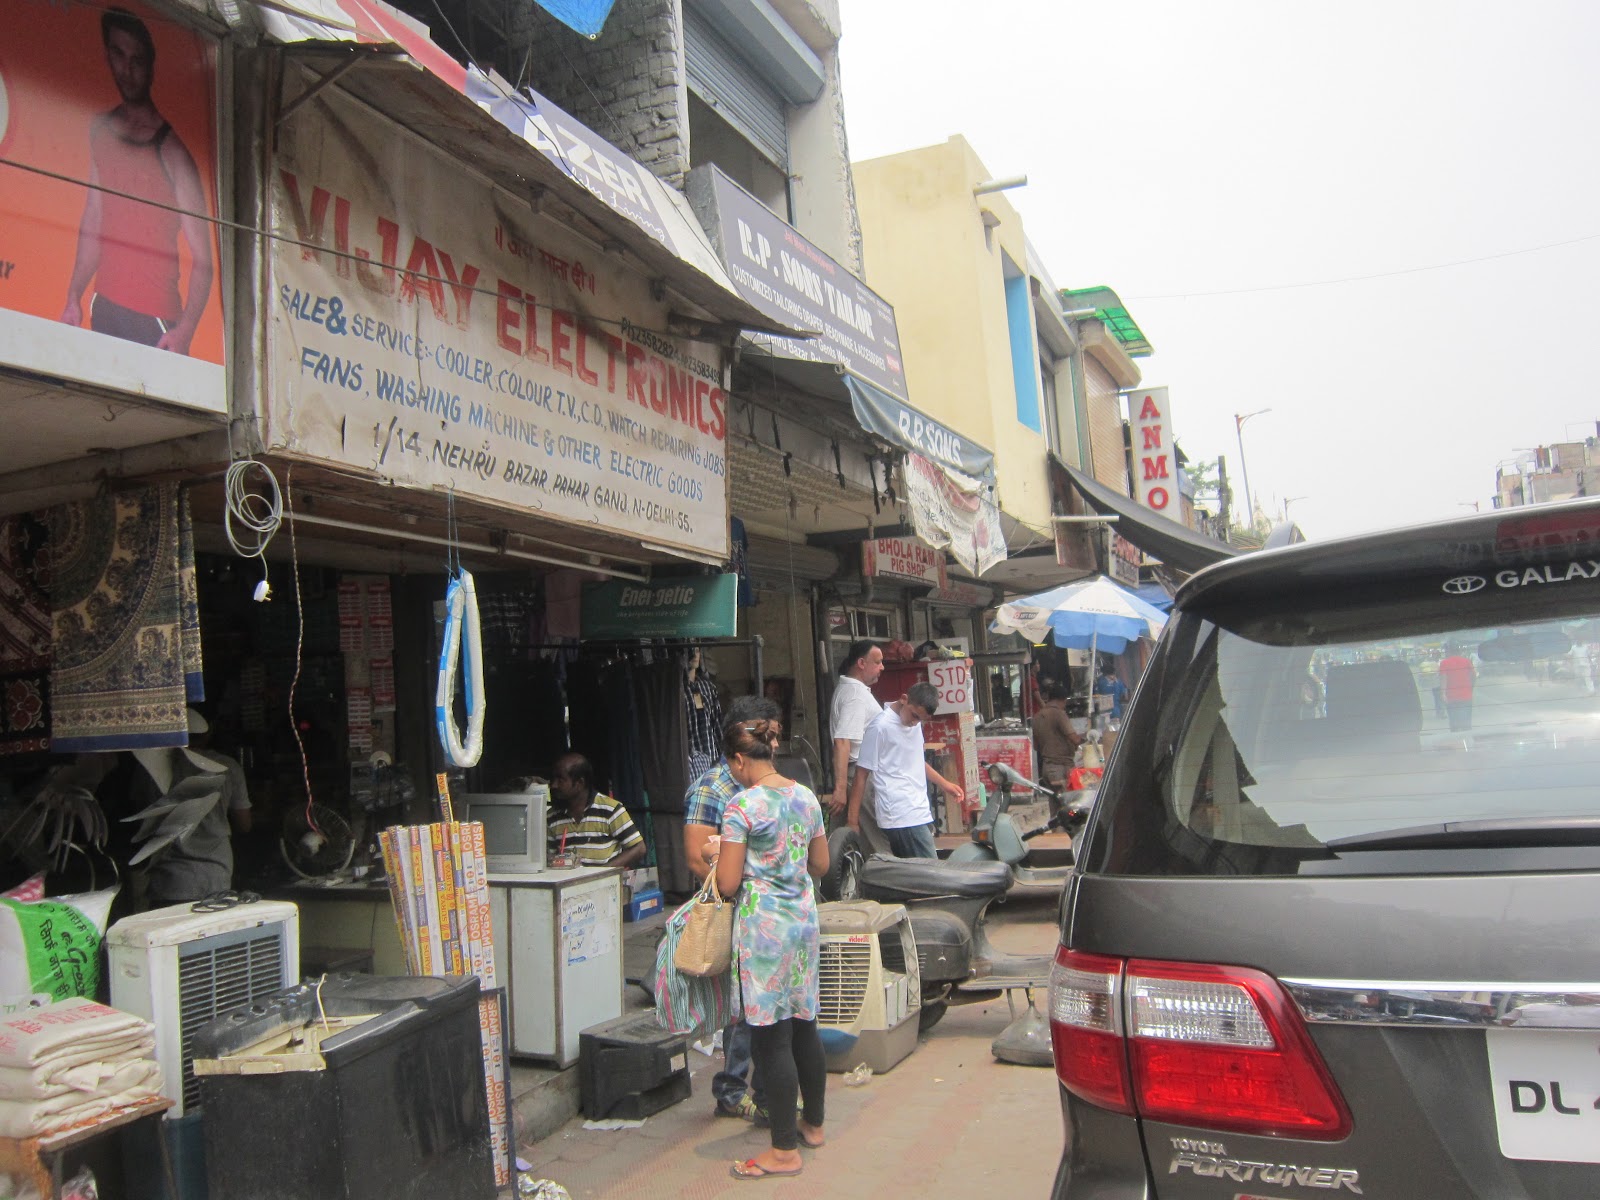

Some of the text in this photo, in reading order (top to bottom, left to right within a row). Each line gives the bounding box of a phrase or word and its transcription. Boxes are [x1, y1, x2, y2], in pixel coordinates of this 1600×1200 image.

[280, 167, 726, 440] VIJAY ELECTRONICS
[780, 249, 824, 307] SONS
[823, 280, 876, 341] TAILOR
[732, 263, 773, 302] CUSTOMIZED
[771, 287, 804, 322] TAILORING
[858, 346, 887, 373] ACCESSORIES
[819, 338, 838, 360] Gents
[837, 350, 852, 368] Wear
[375, 367, 462, 424] WASHING
[468, 400, 540, 449] MACHINE
[543, 428, 555, 458] &
[558, 434, 603, 471] OTHER
[610, 448, 664, 489] ELECTRIC
[668, 471, 704, 503] GOODS
[498, 374, 552, 413] COLOUR
[607, 409, 647, 442] WATCH
[651, 427, 702, 466] REPAIRING
[703, 450, 726, 478] JOBS
[925, 422, 964, 467] SONS
[432, 438, 498, 482] NEHRU
[552, 473, 591, 508] PAHAR
[1139, 395, 1169, 510] ANMO
[878, 538, 912, 562] BHOLA
[915, 545, 936, 566] RAM
[891, 557, 905, 573] PIG
[906, 561, 926, 577] SHOP
[933, 665, 966, 688] STD
[471, 823, 486, 859] SRAM
[468, 897, 482, 941] OSRAM
[479, 902, 495, 949] OSRAM
[494, 1080, 508, 1125] OSRAM
[1509, 1079, 1580, 1115] DL
[1170, 1137, 1228, 1156] TOYOTA
[1168, 1151, 1364, 1195] FORTUNER
